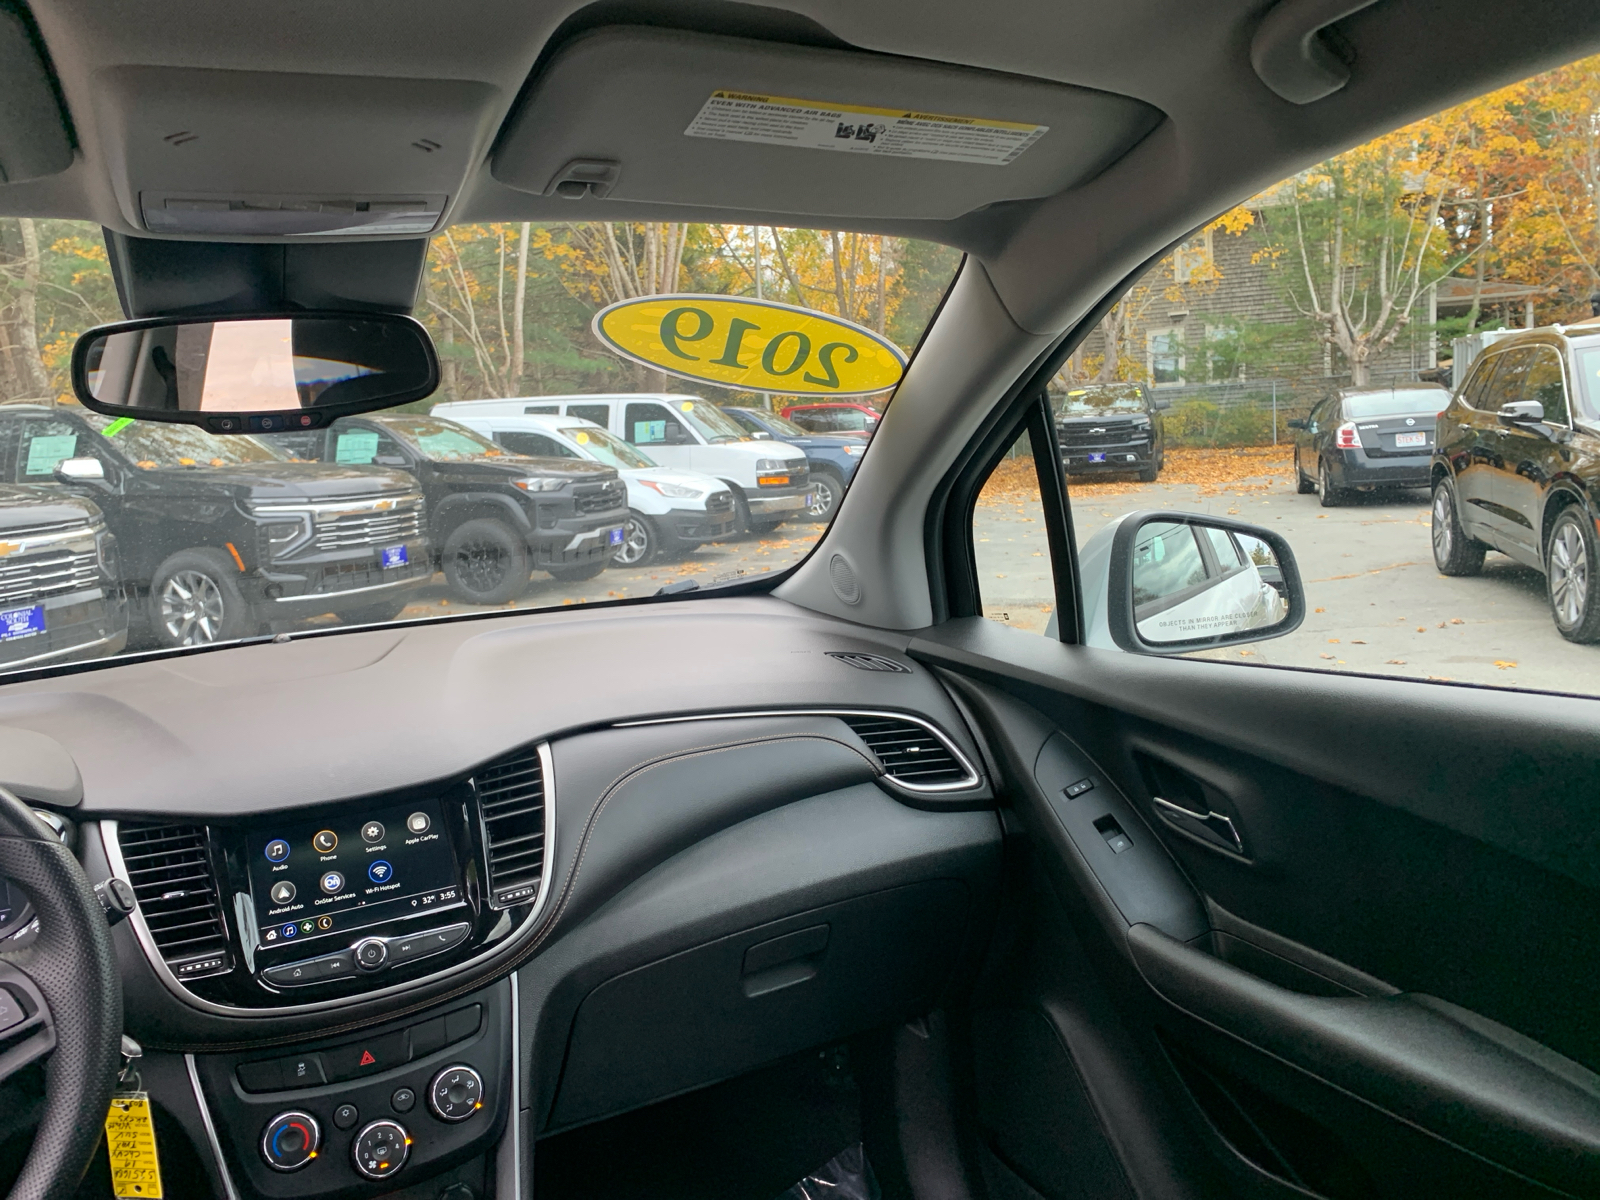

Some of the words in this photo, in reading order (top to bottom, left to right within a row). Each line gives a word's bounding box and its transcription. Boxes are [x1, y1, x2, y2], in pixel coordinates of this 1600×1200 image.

[727, 93, 769, 103] WARNING
[759, 104, 802, 113] ADVANCED
[913, 114, 975, 124] AVERTISSEMENT
[1159, 620, 1186, 628] OBJECTS
[1214, 620, 1237, 628] APPEAR
[365, 845, 387, 853] Settings
[380, 883, 401, 891] Hotspot
[314, 896, 333, 905] OnStar
[334, 893, 356, 901] Services
[440, 891, 455, 900] 3:55
[269, 906, 290, 915] Android
